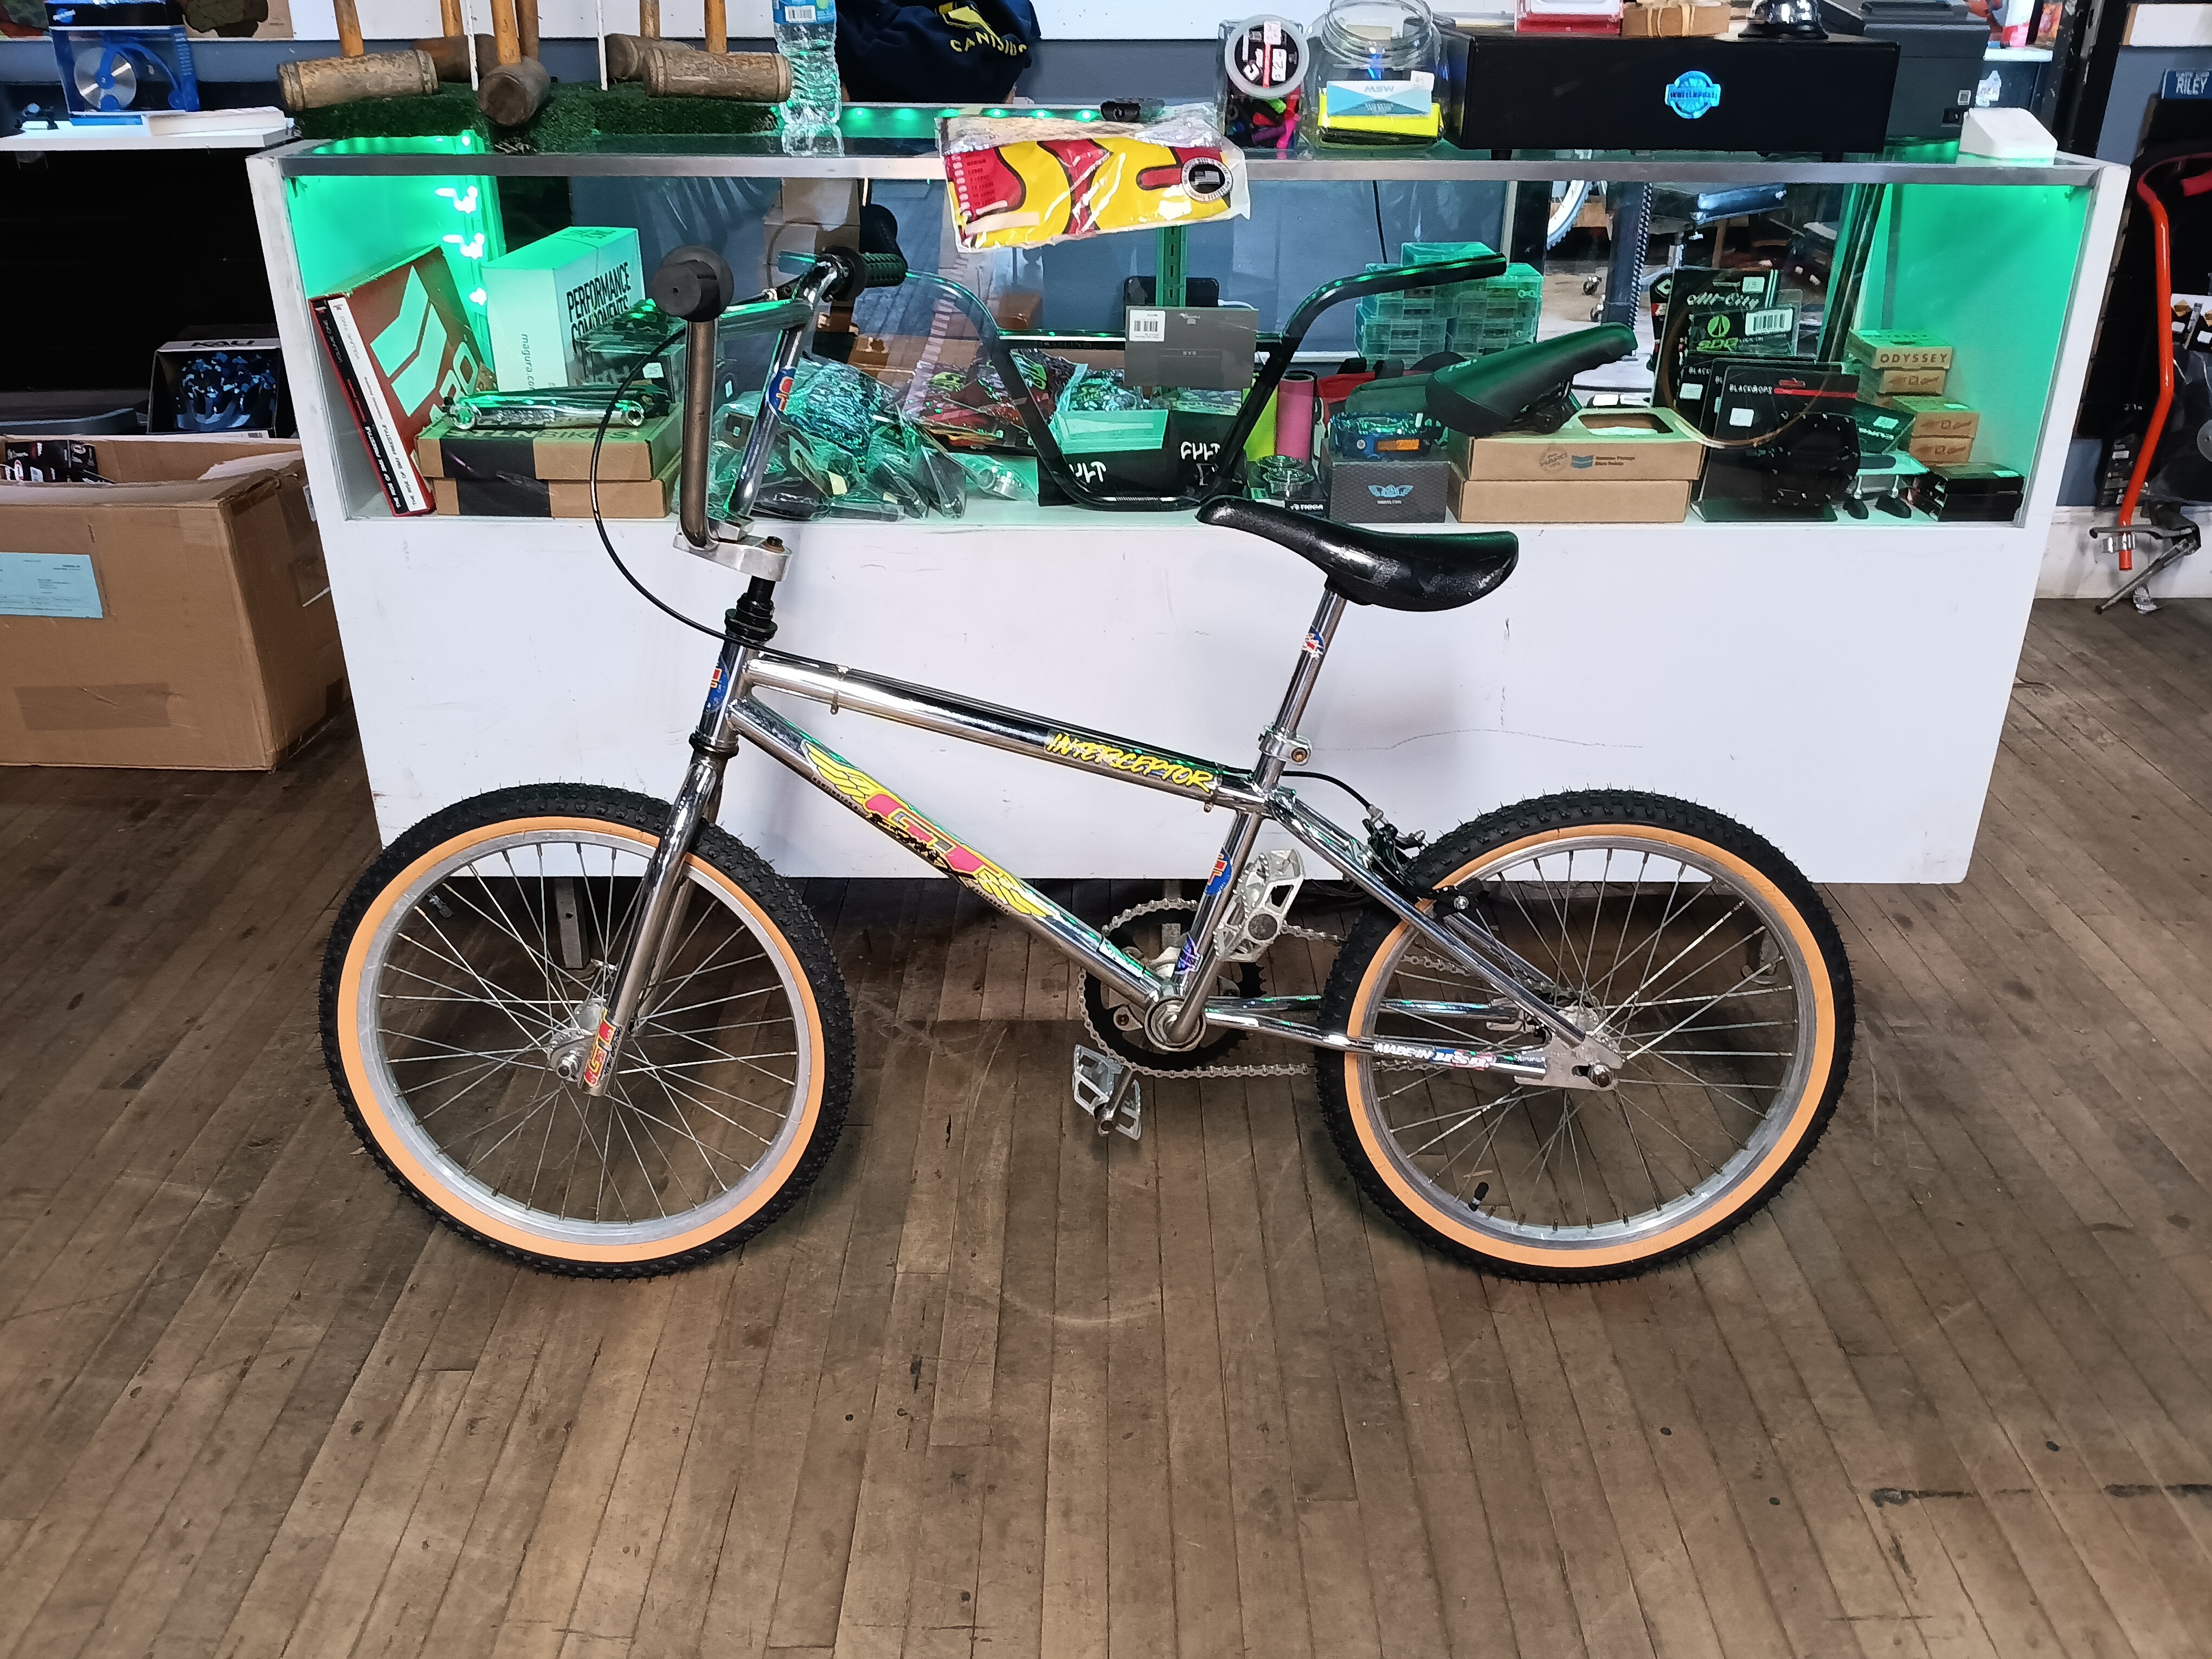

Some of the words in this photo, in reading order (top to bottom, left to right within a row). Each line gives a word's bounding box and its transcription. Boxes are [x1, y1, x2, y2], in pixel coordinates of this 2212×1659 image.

[2176, 77, 2208, 95] RILEY
[566, 261, 632, 323] PERFORMANCE
[1880, 353, 1947, 363] ODYSSEY
[1069, 461, 1107, 484] ULT
[1045, 733, 1213, 793] INTERCEPTOR
[863, 791, 1002, 875] GT
[1373, 1042, 1416, 1057] MADE
[1414, 1046, 1433, 1060] IN
